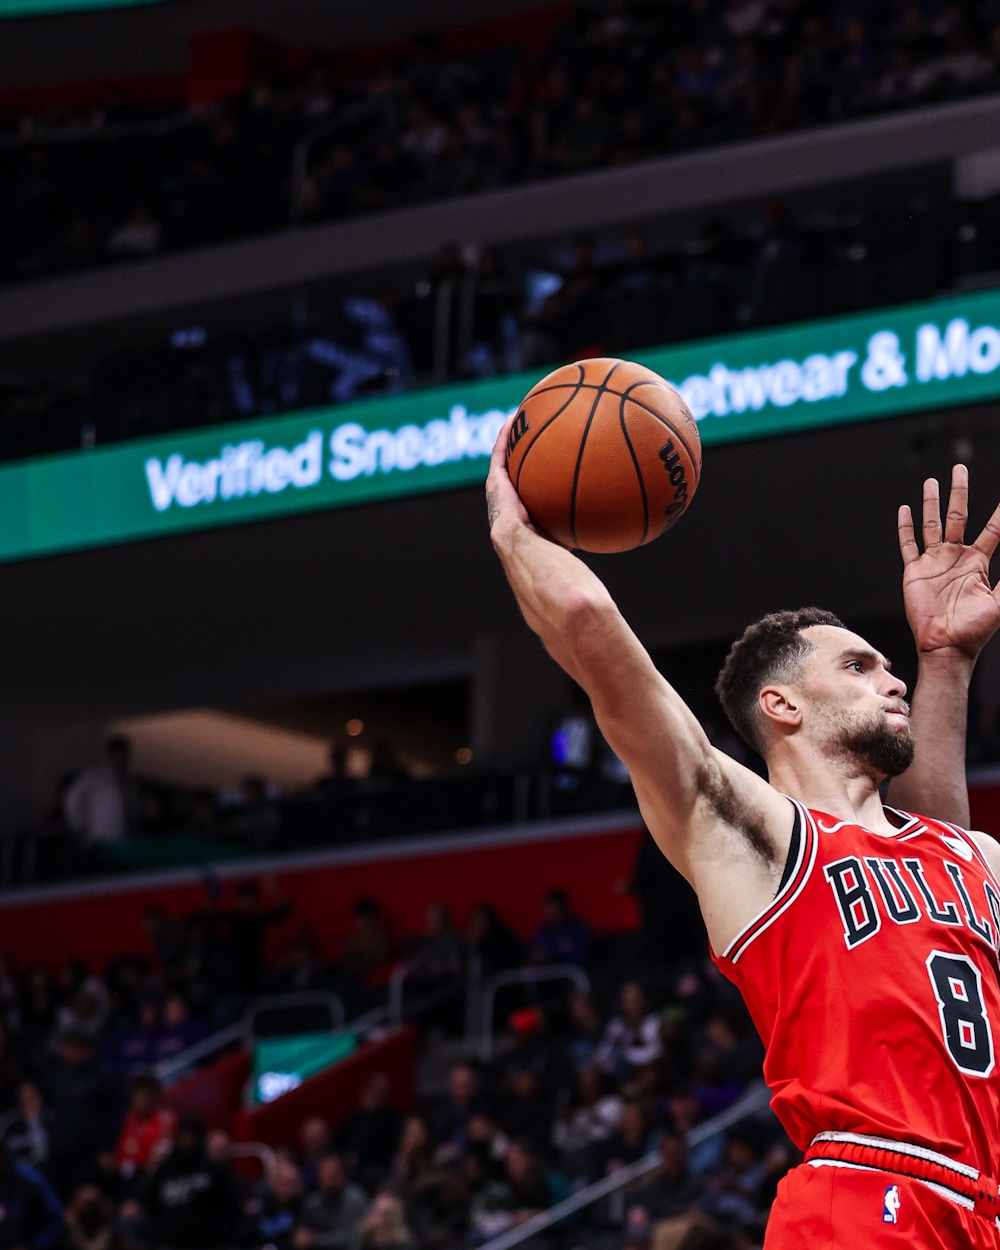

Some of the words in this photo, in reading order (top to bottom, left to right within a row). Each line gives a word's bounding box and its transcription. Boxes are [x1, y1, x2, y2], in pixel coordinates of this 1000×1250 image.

[145, 429, 322, 512] Verified
[861, 330, 908, 392] &
[925, 948, 996, 1078] 8
